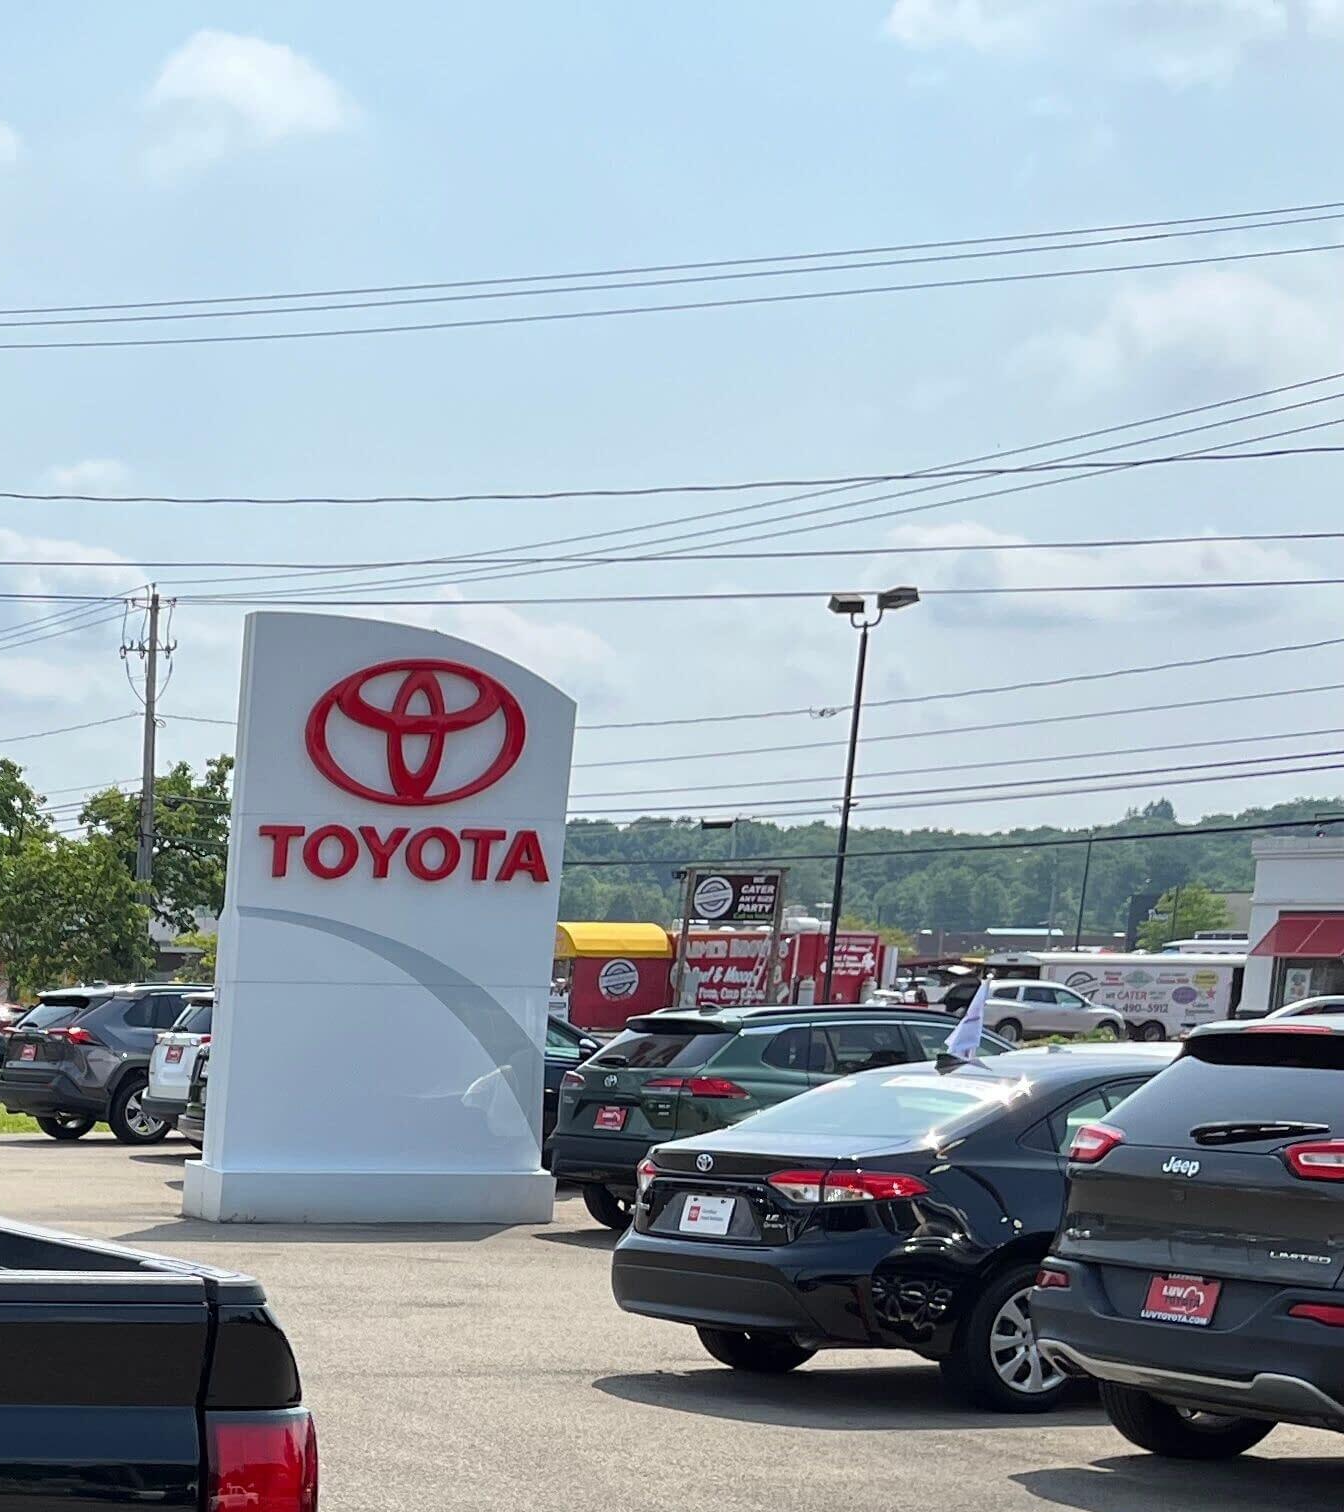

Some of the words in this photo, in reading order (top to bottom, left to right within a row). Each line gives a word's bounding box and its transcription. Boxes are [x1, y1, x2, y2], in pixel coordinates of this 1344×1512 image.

[258, 824, 550, 883] TOYOTA
[740, 884, 775, 894] CATER
[737, 903, 771, 913] PARTY
[1117, 990, 1147, 1000] CATER
[1162, 1156, 1201, 1178] Jeep
[1269, 1250, 1333, 1265] LIMITED
[1162, 1285, 1185, 1298] LUV
[1140, 1308, 1208, 1326] LUVTOYOTA.COM
